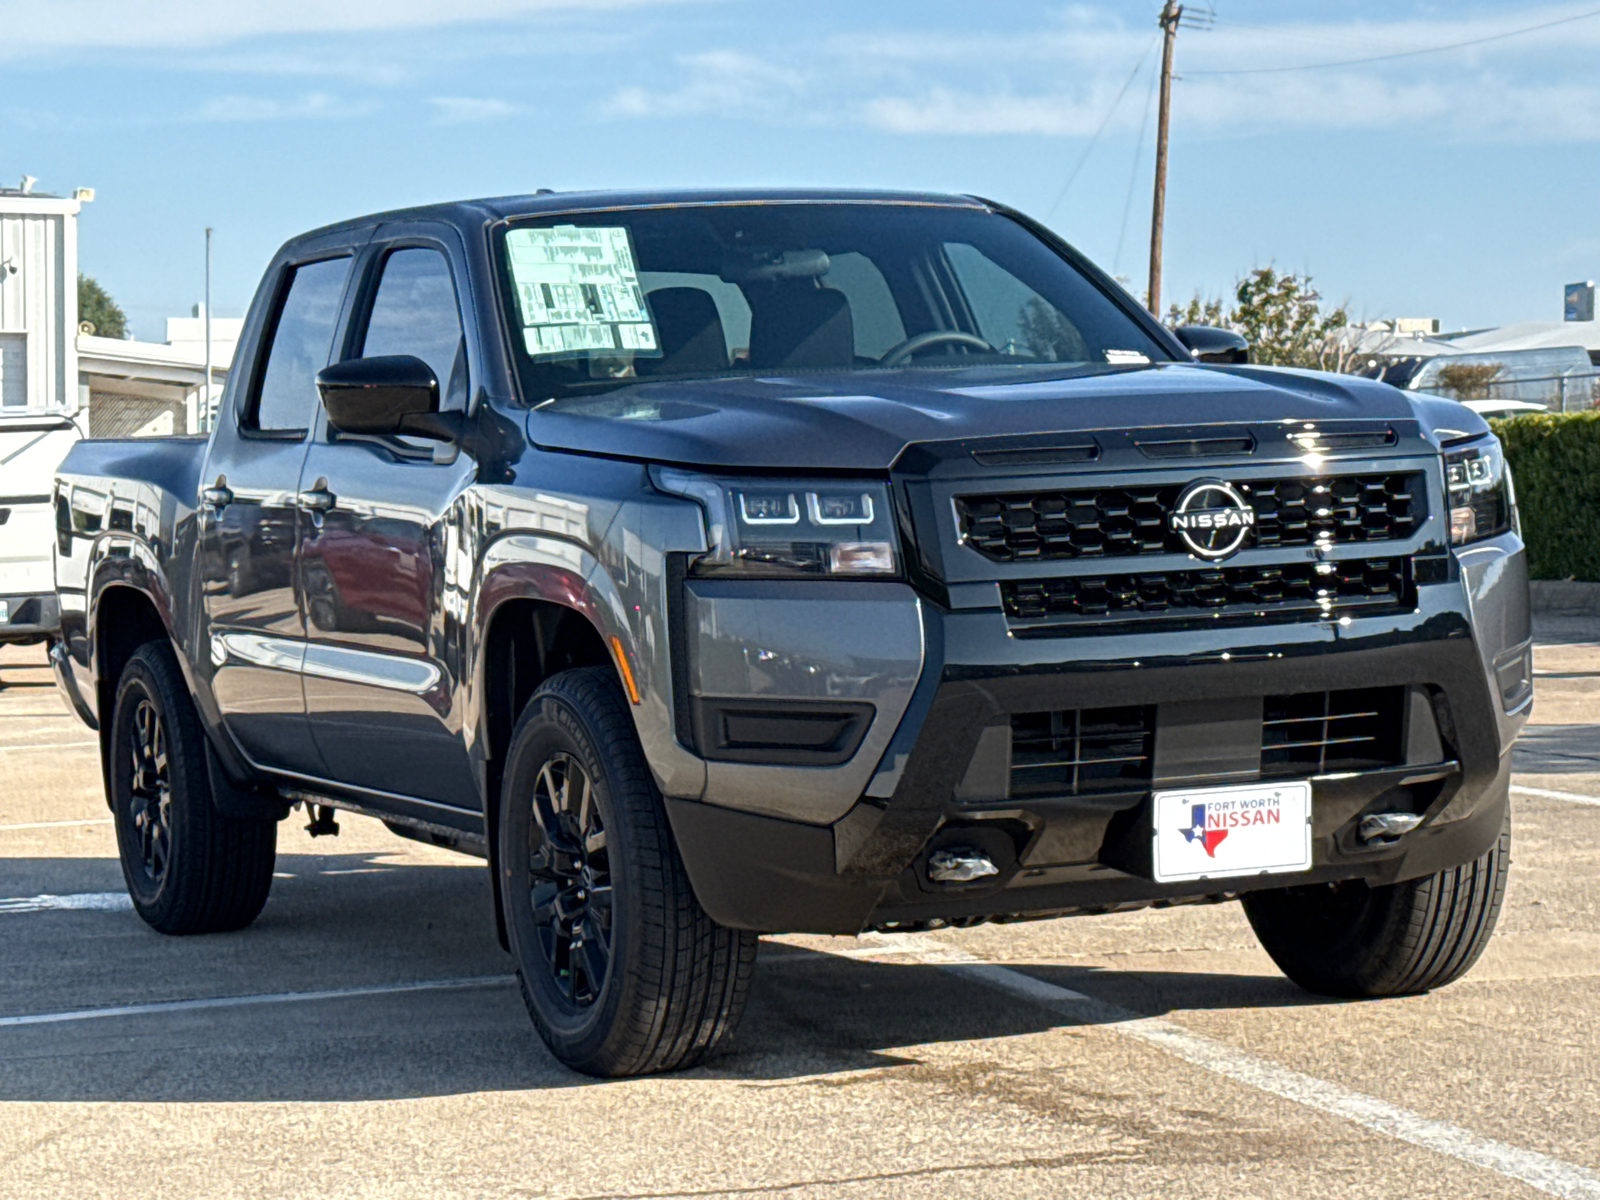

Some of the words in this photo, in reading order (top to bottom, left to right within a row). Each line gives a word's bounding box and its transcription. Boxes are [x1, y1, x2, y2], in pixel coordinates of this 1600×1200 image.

[1172, 512, 1254, 528] NISSAN
[1207, 801, 1236, 811] FORT
[1240, 798, 1280, 809] WORTH
[1207, 808, 1280, 828] NISSAN
